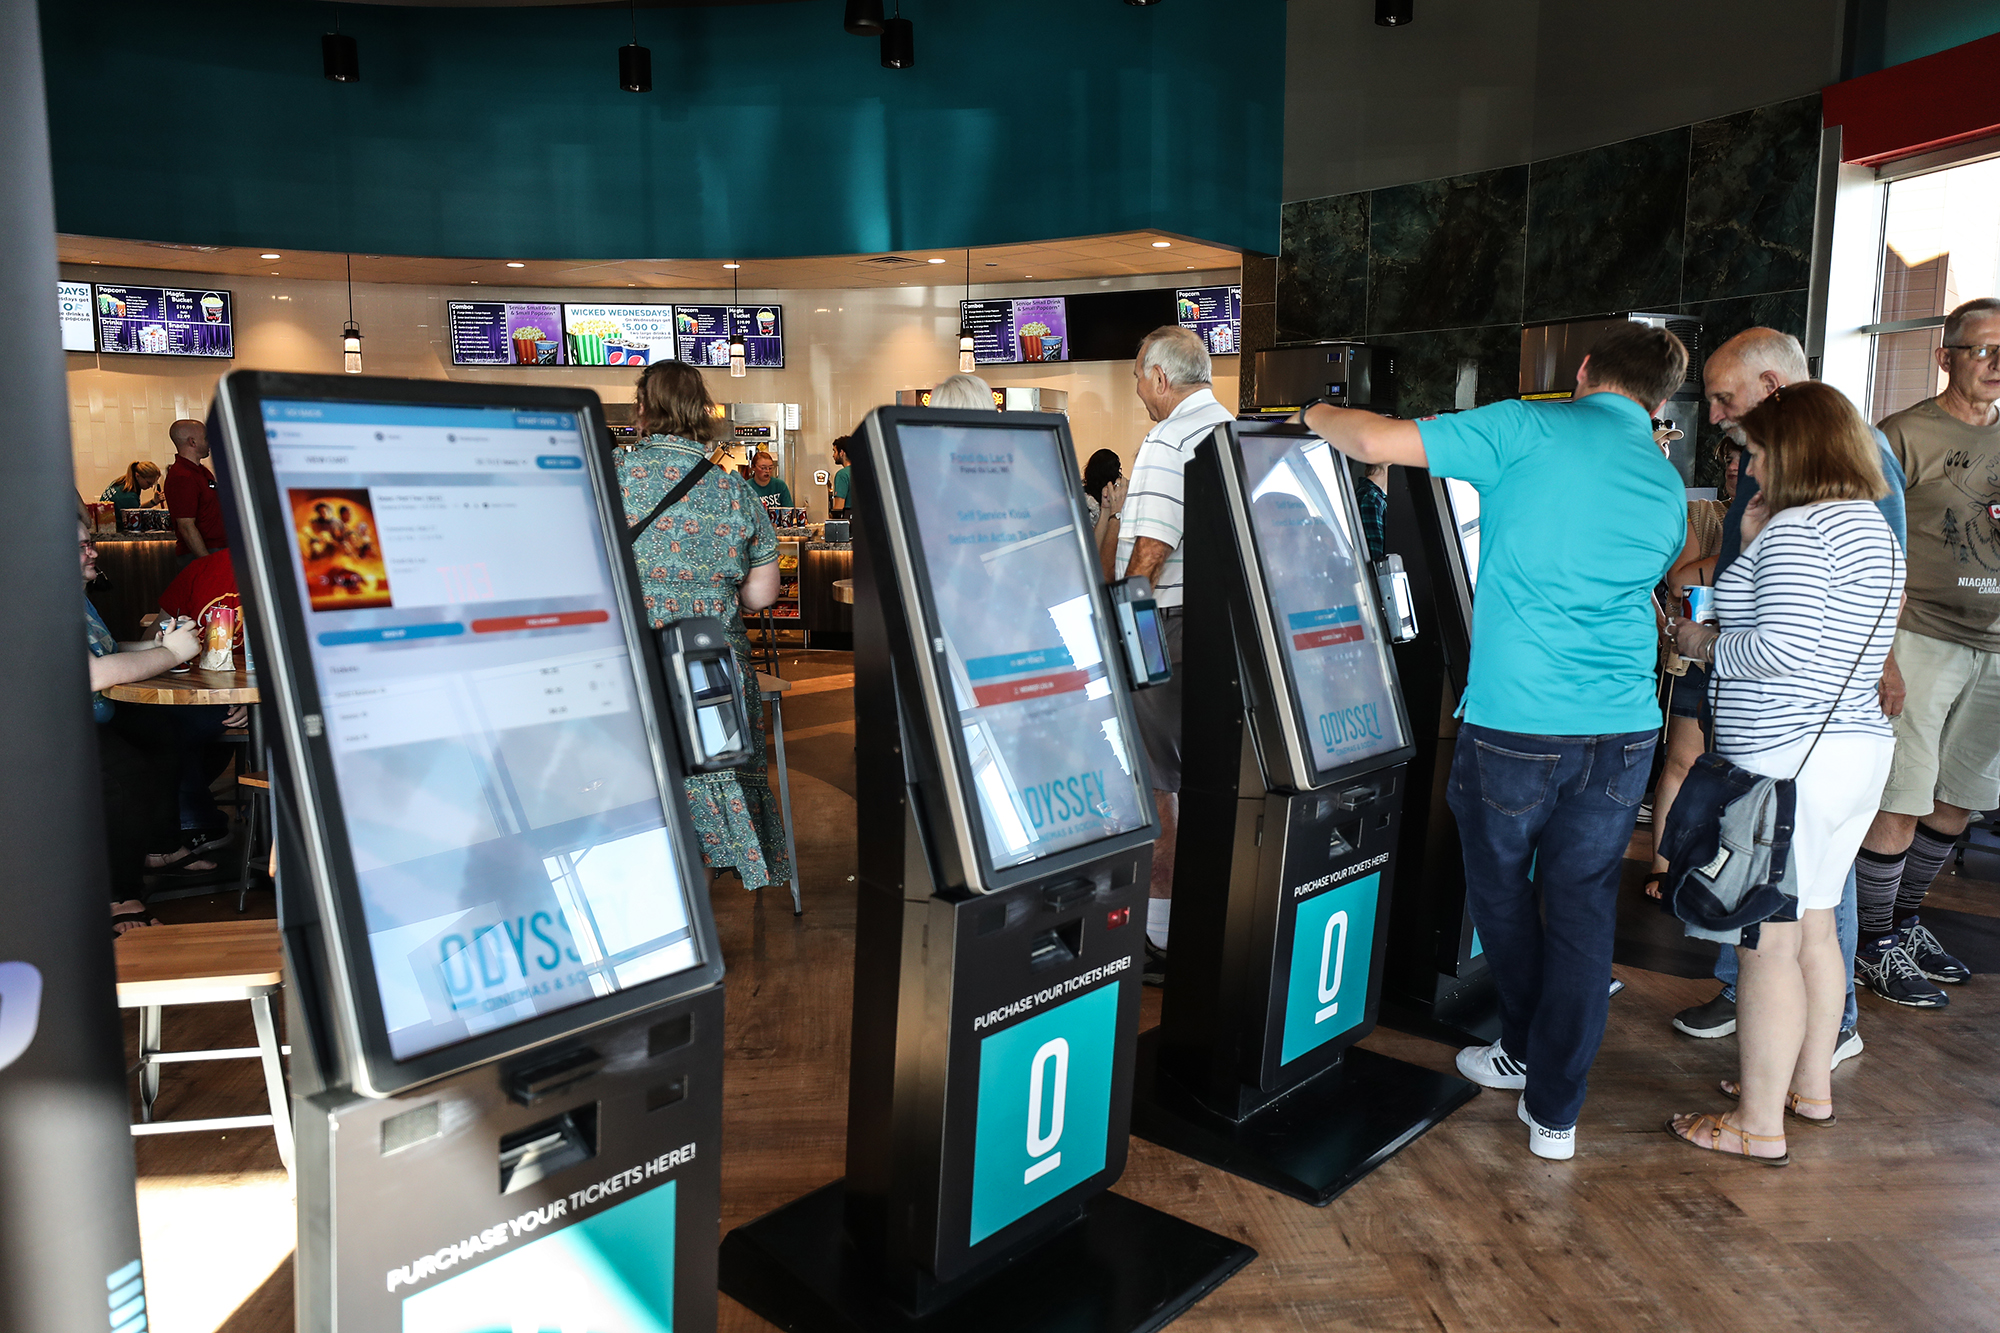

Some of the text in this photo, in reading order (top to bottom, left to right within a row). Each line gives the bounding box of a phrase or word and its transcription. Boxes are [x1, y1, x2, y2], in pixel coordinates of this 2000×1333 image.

[58, 287, 88, 296] DAYS!
[1958, 577, 1997, 587] NIAGARA
[1319, 702, 1383, 747] ODYSSEY
[1021, 769, 1112, 829] DYSSEY
[1294, 852, 1389, 898] PURCHASE YOUR TICKETS HERE!
[440, 908, 583, 1001] ODYSS
[974, 955, 1132, 1032] PURCHASE YOUR TICKETS HERE!
[1538, 1128, 1570, 1140] adidas
[386, 1142, 697, 1292] PURCHASE YOUR TICKETS HERE!
